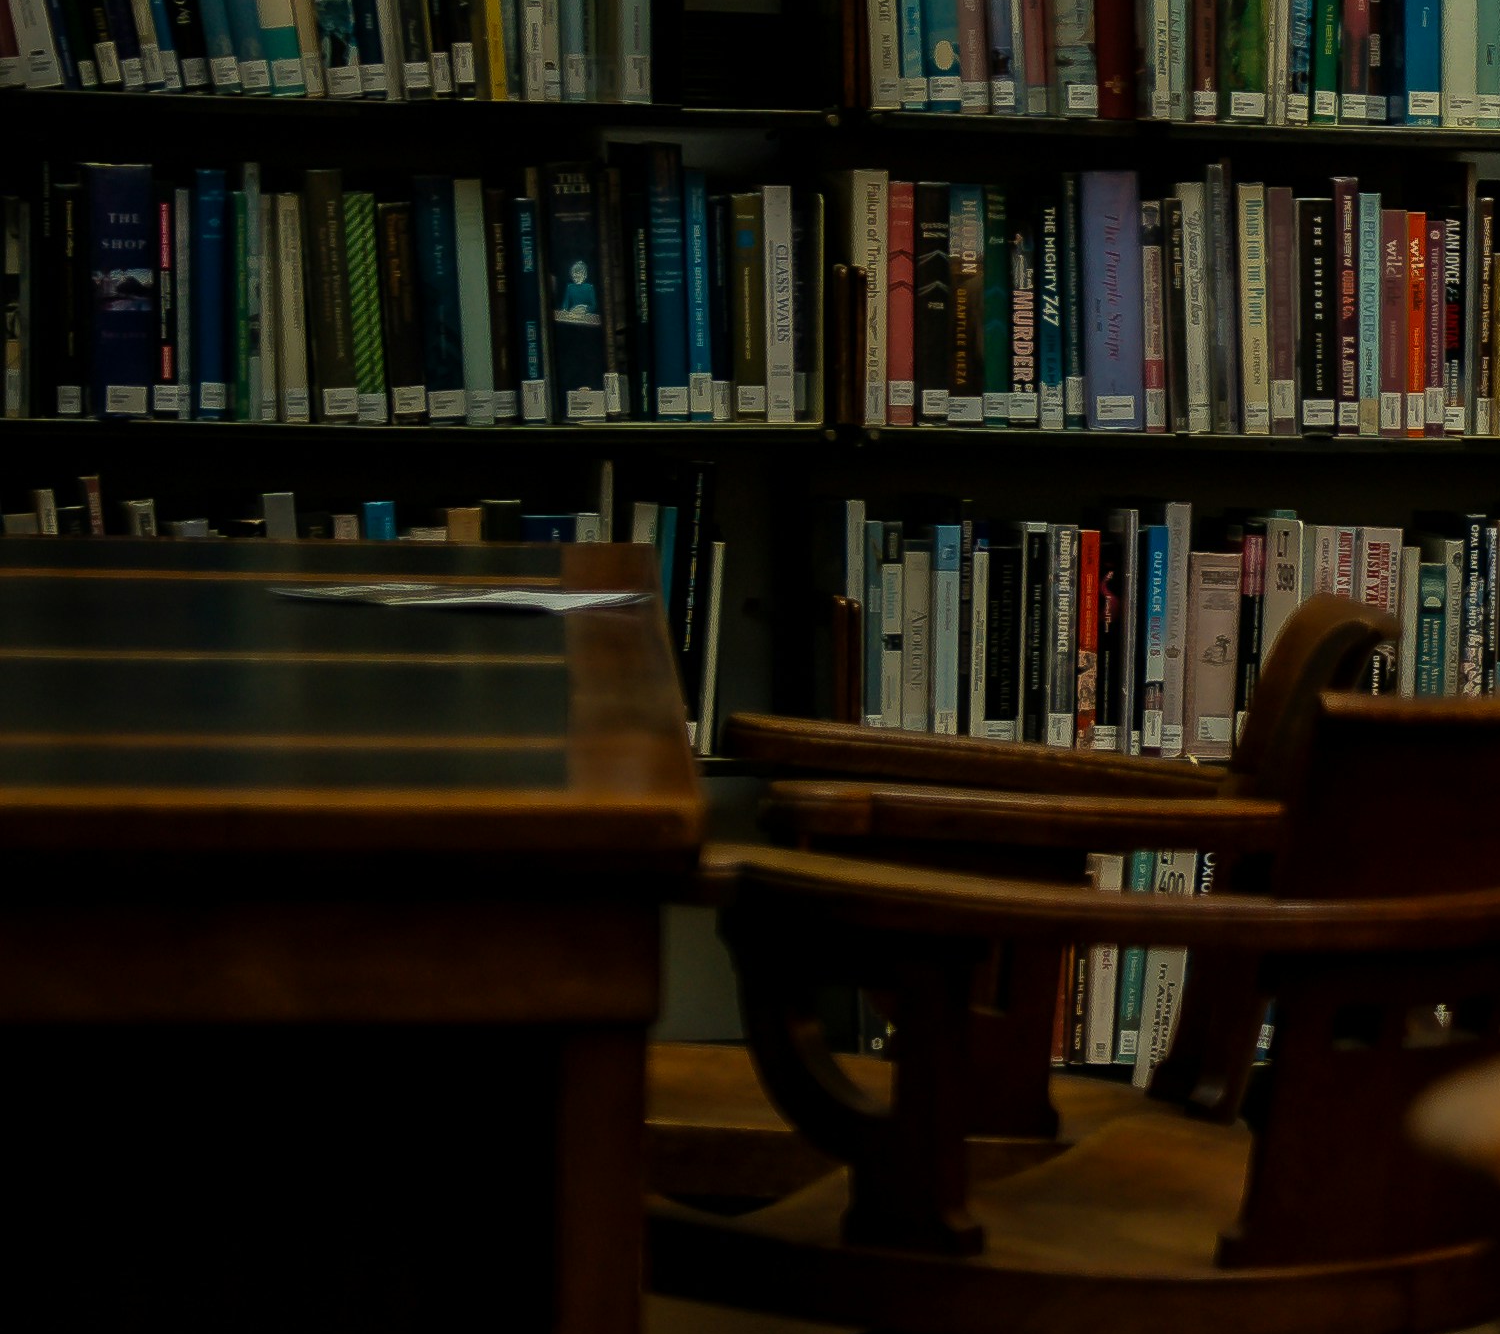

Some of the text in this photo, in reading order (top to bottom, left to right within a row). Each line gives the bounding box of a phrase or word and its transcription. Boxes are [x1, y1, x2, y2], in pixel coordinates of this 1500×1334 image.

[102, 238, 148, 251] SHOP
[107, 212, 144, 225] THE
[867, 183, 881, 298] Failure of Triumph
[1445, 219, 1460, 285] ALAN JOYCE
[776, 245, 790, 342] CLASS WARS
[1044, 207, 1059, 325] THE MIGHTY 747
[1104, 215, 1123, 361] The Purple Stripe
[1363, 220, 1377, 343] PEOPLE MOVERS
[1012, 290, 1033, 381] MURDER
[1001, 589, 1013, 645] GETTING
[1057, 530, 1071, 653] UNDER THE INFLUENCE
[1153, 551, 1164, 612] OUTBACK
[1000, 668, 1011, 715] GARLIC
